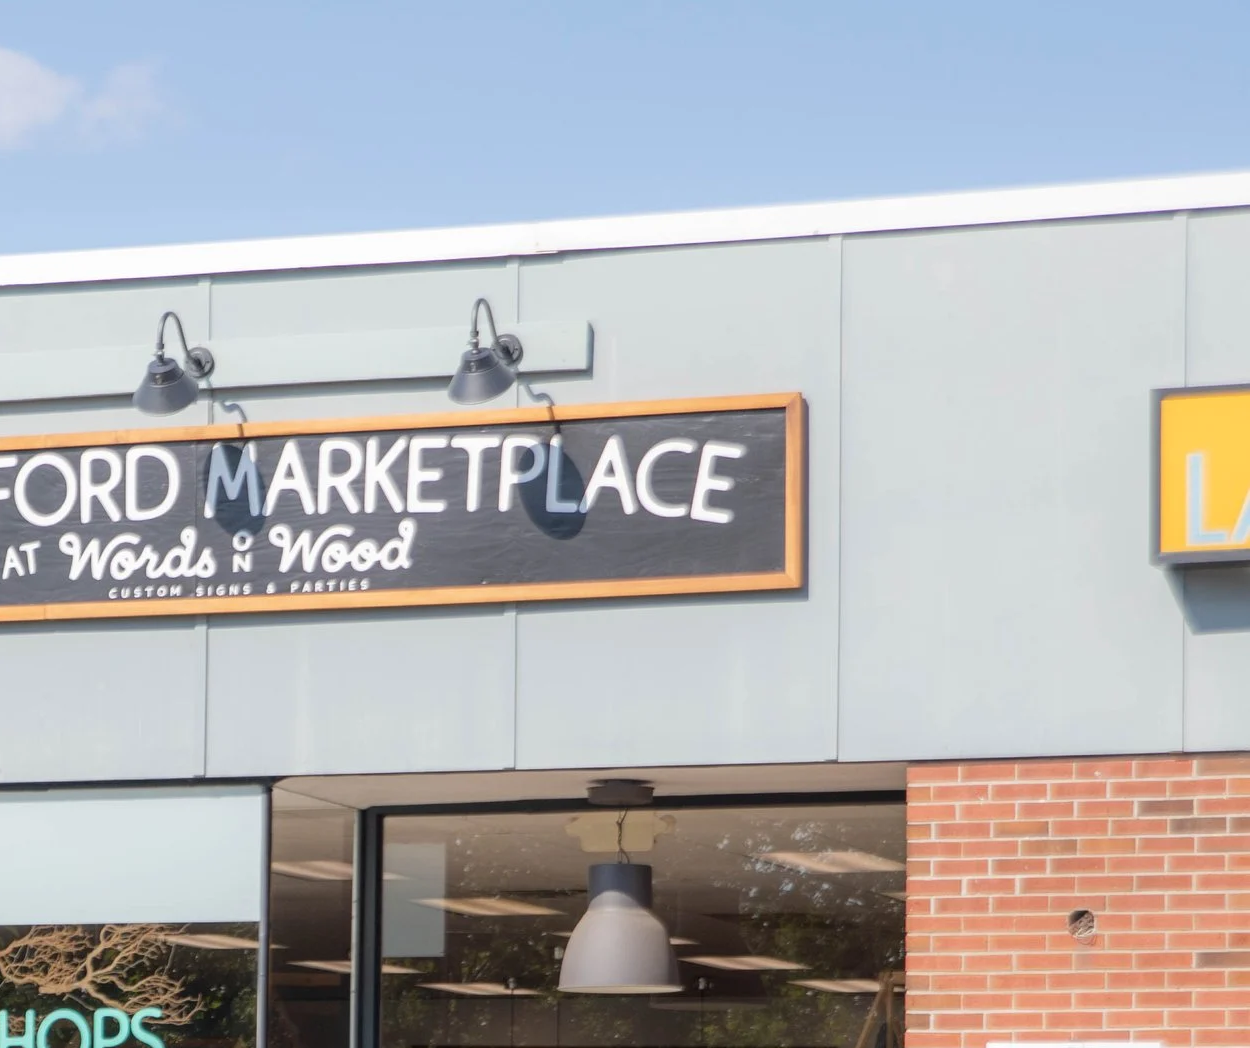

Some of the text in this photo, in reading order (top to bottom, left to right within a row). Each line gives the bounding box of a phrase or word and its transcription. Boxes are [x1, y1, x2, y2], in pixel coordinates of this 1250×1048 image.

[204, 433, 748, 525] MARKETPLACE
[1186, 452, 1250, 546] L
[2, 541, 42, 580] AT
[58, 525, 218, 582] Words
[268, 517, 418, 575] Wood
[108, 584, 182, 600] CUSTOM
[195, 582, 252, 598] SIGNS
[290, 578, 371, 594] PARTIES
